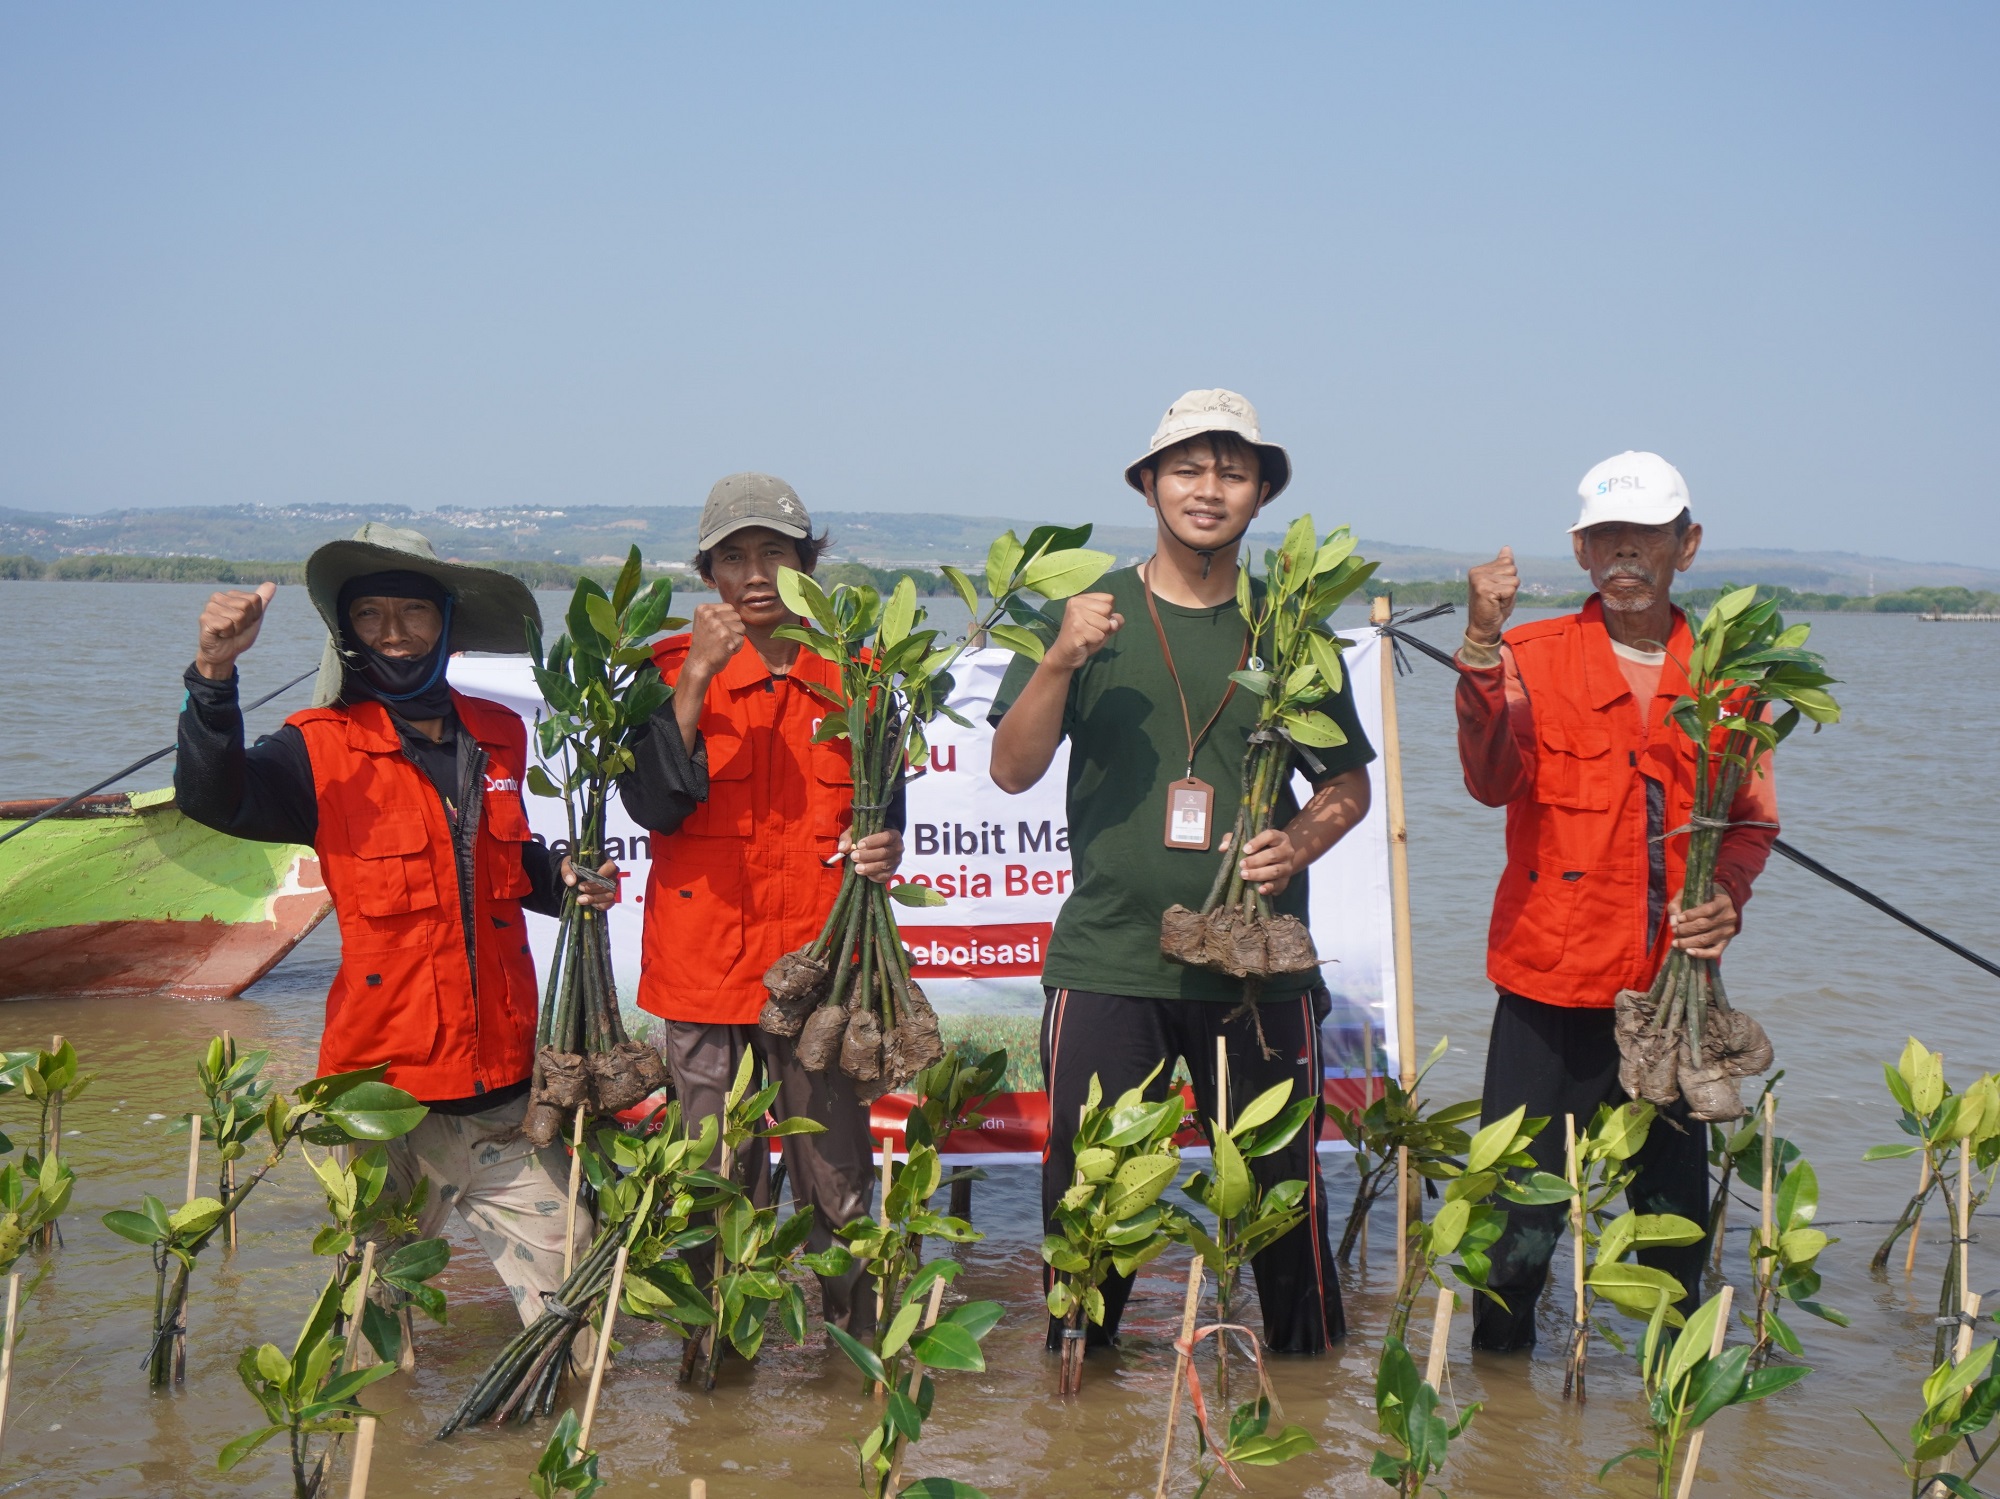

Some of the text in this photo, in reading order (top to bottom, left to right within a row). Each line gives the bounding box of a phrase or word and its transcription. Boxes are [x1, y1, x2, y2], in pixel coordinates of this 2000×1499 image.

[914, 821, 1006, 856] Bibit
[1005, 864, 1073, 897] Ber
[901, 936, 1040, 966] eboisasi
